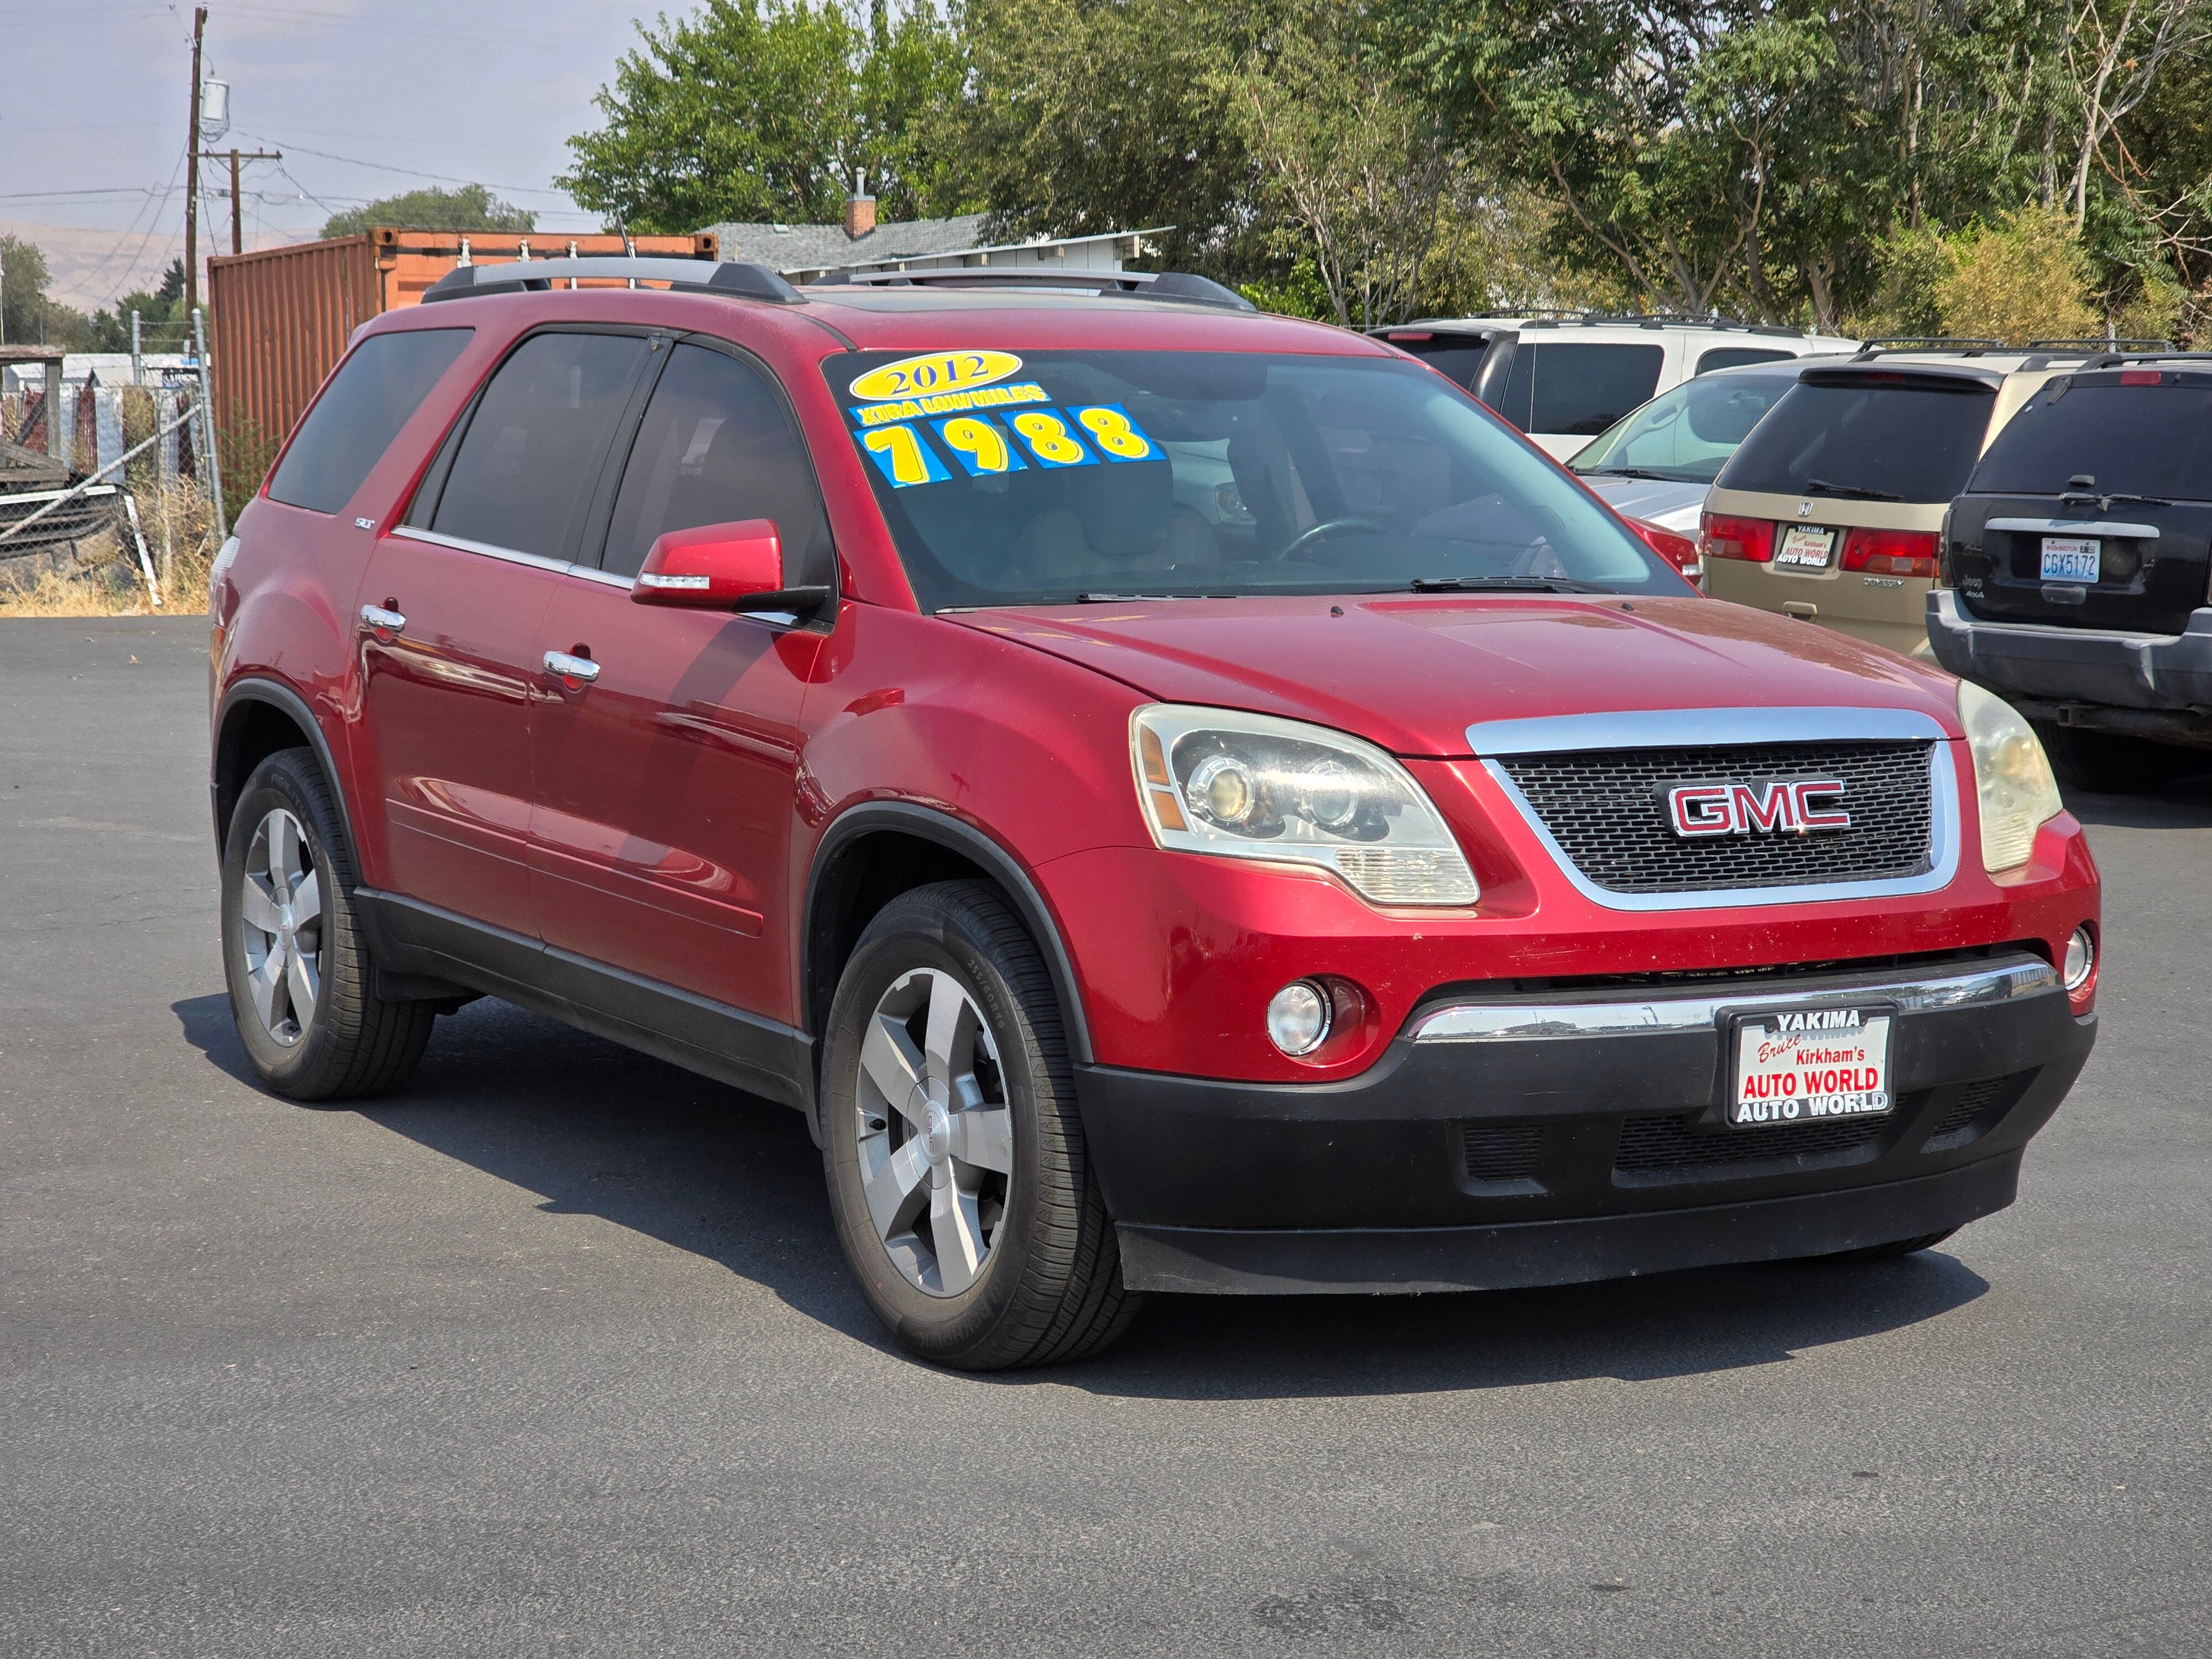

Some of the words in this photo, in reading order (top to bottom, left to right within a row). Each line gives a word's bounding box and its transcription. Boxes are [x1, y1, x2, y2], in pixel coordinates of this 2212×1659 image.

[885, 355, 989, 395] 2012
[857, 400, 925, 426] XTRA
[919, 392, 974, 414] LOW
[971, 384, 1047, 405] MILES
[863, 408, 1151, 484] 7988
[354, 517, 375, 529] SLT
[1798, 525, 1824, 534] YAKIMA
[1776, 554, 1798, 564] AUTO
[1800, 556, 1827, 566] WORLD
[1785, 546, 1803, 556] AUTO
[1804, 548, 1829, 559] WORLD
[2044, 554, 2095, 576] CGX5172
[1668, 780, 1851, 837] GMC
[1776, 1010, 1860, 1032] YAKIMA
[1757, 1032, 1803, 1063] Bruce
[1796, 1046, 1865, 1066] Kirkham's
[1743, 1072, 1797, 1099] AUTO
[1803, 1067, 1879, 1094] WORLD
[1736, 1098, 1800, 1123] AUTO
[1808, 1092, 1888, 1117] WORLD
